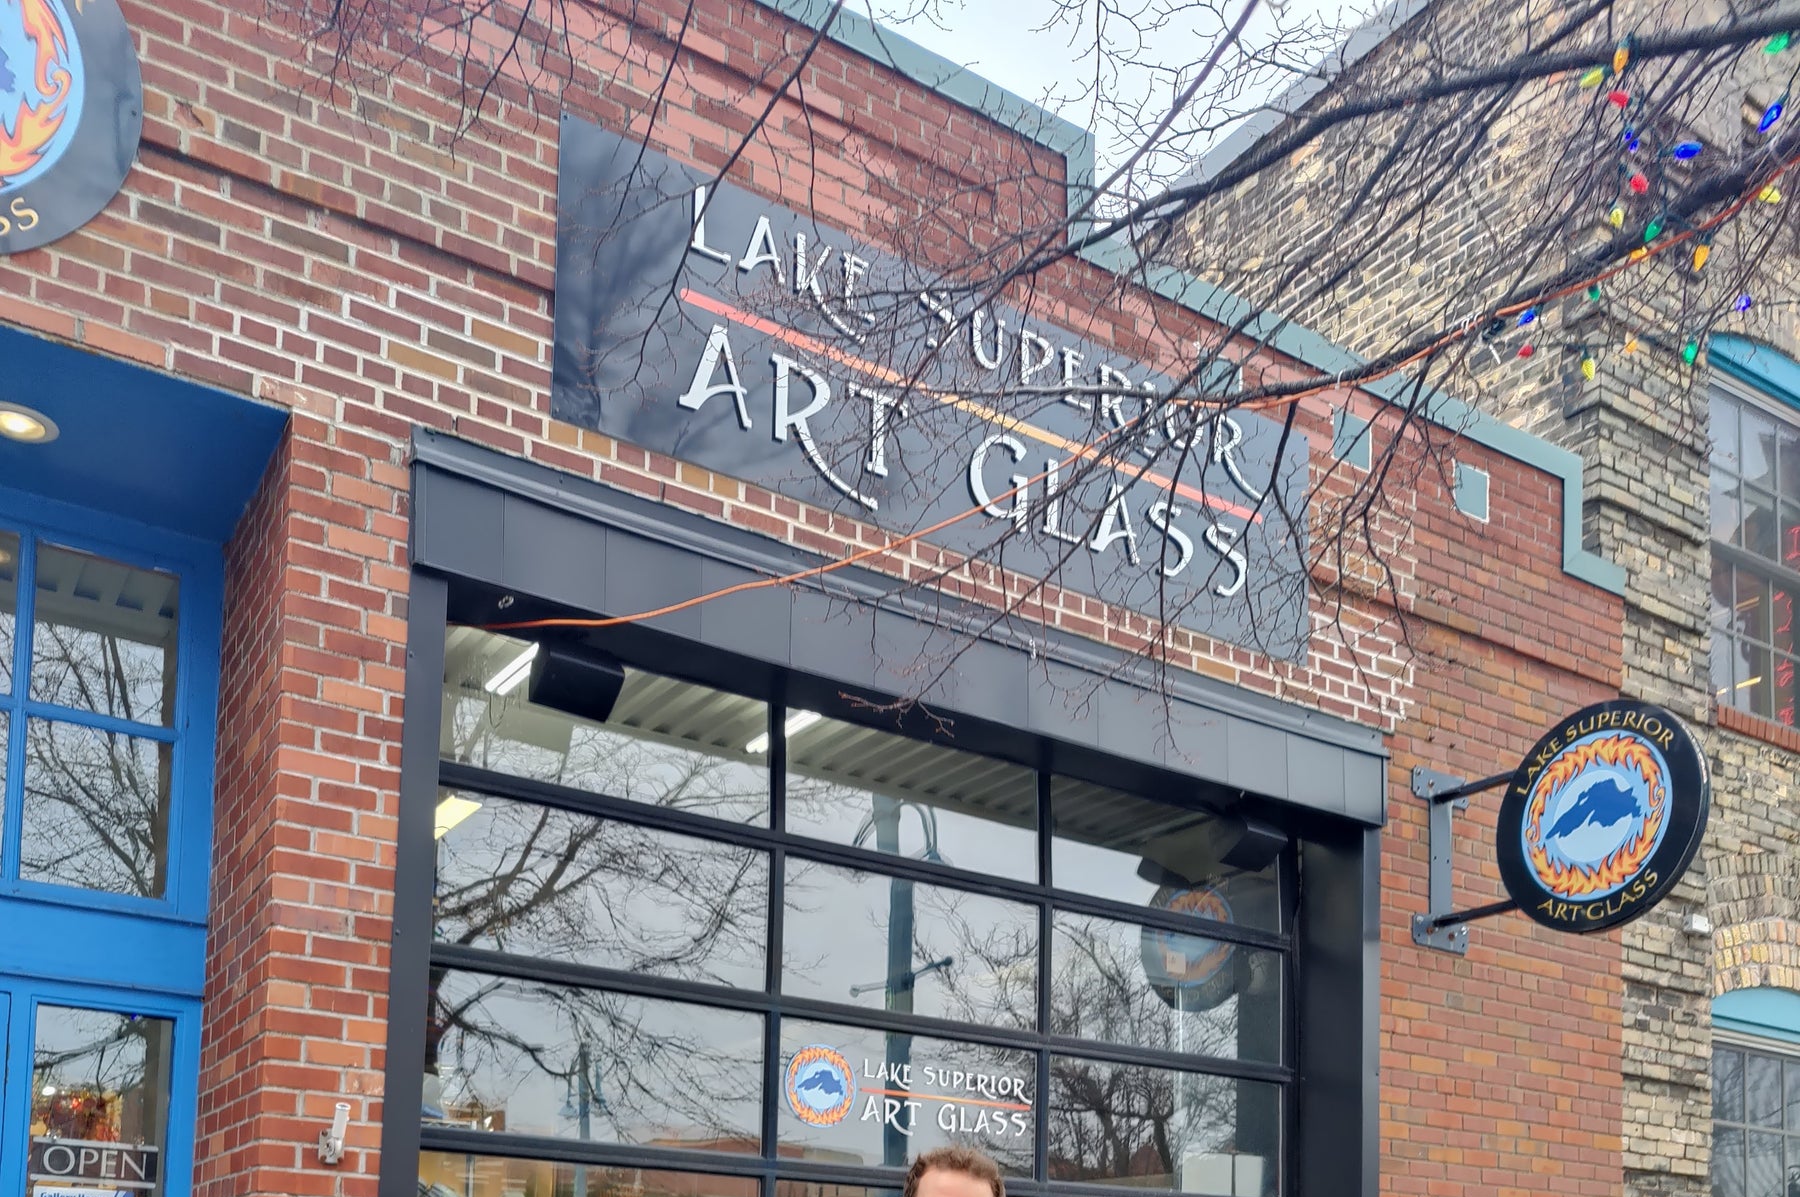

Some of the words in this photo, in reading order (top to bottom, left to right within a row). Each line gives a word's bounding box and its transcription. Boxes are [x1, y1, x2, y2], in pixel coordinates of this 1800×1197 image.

[690, 184, 876, 344] LAKE
[920, 290, 1268, 503] SUPERIOR
[679, 323, 909, 511] ART
[969, 433, 1250, 597] GLASS
[1516, 735, 1564, 797] LAKE
[1566, 710, 1675, 750] SUPERIOR
[1537, 897, 1583, 923] ART
[1586, 867, 1659, 922] GLASS
[863, 1058, 914, 1091] LAKE
[922, 1066, 1034, 1105] SUPERIOR
[860, 1095, 922, 1136] ART
[937, 1103, 1028, 1137] GLASS
[42, 1145, 148, 1181] OPEN
